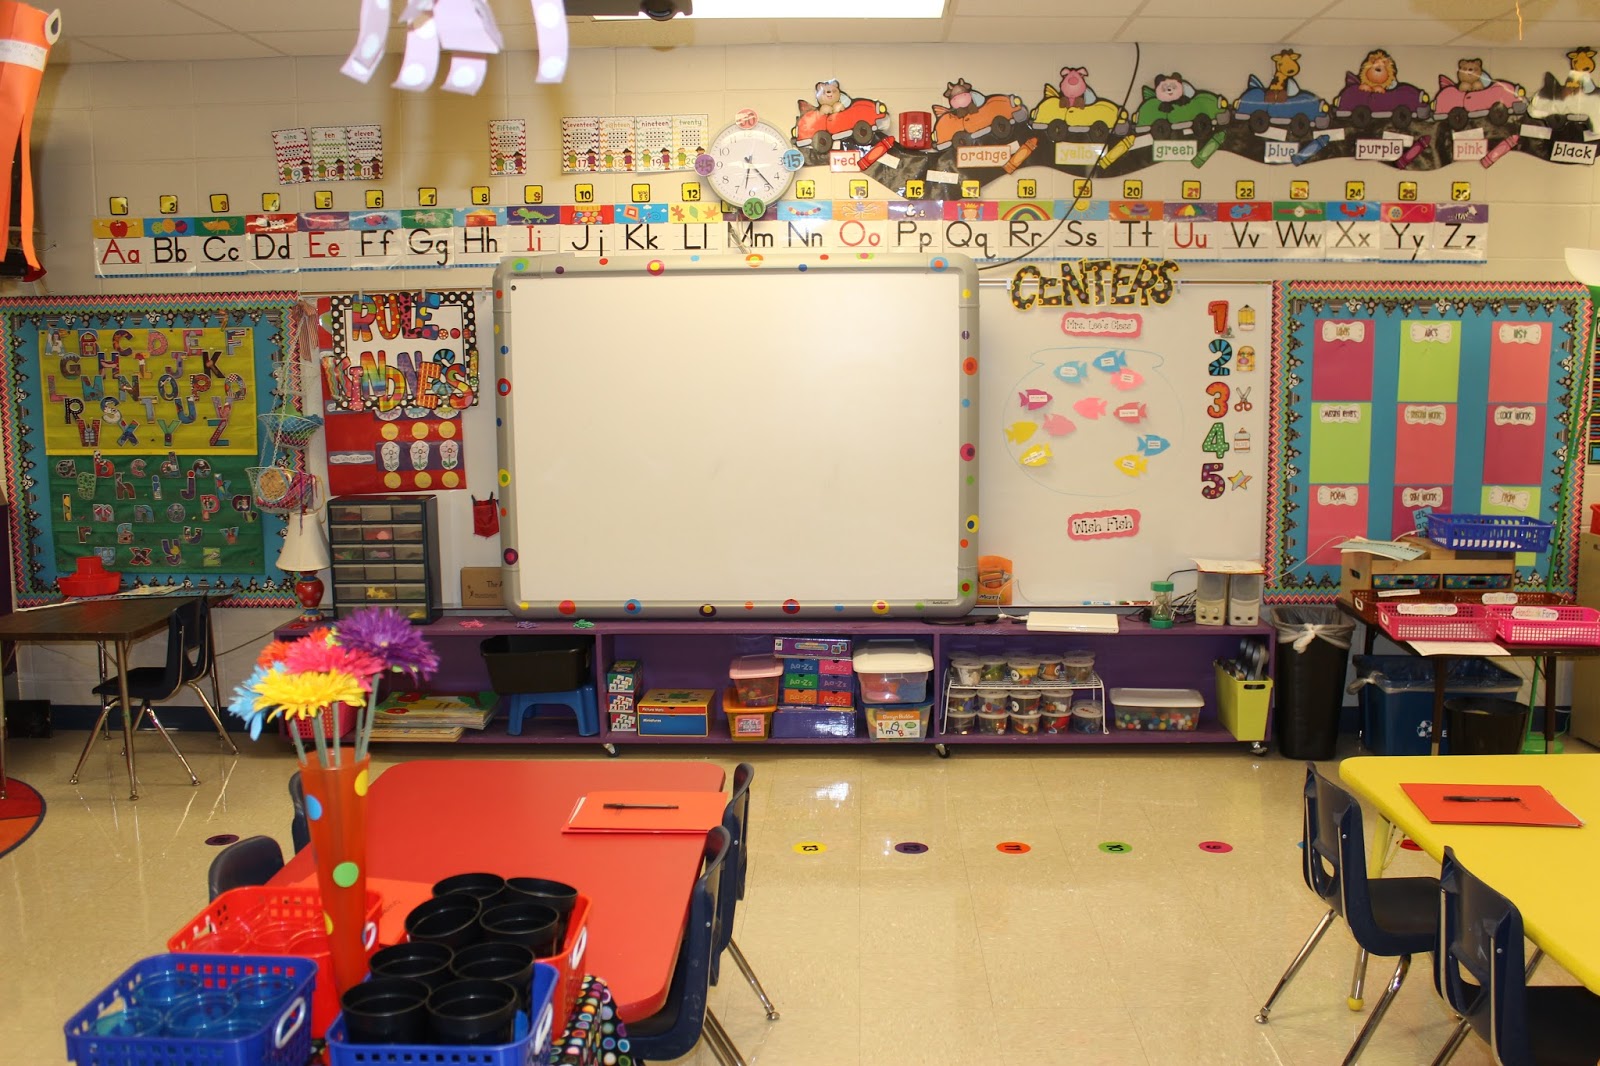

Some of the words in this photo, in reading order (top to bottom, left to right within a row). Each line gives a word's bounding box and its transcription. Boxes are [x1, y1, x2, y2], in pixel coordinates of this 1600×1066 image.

[497, 124, 520, 132] fifteen
[679, 119, 702, 128] twenty
[720, 148, 730, 156] 10
[960, 150, 1008, 164] orange
[1061, 148, 1099, 161] yello
[1156, 144, 1194, 158] green
[1268, 144, 1295, 156] blue
[1358, 142, 1400, 158] purple
[1457, 142, 1483, 158] pink
[1554, 144, 1592, 159] black
[504, 162, 514, 170] 15
[578, 160, 586, 168] 17
[614, 159, 623, 168] 18
[652, 159, 662, 167] 19
[716, 162, 724, 170] 9
[834, 154, 857, 166] red
[294, 169, 300, 180] 9
[363, 168, 370, 176] 11
[722, 176, 730, 184] 8
[735, 186, 740, 194] 7
[748, 189, 756, 197] 6
[120, 204, 126, 213] 1
[170, 202, 175, 212] 2
[221, 201, 228, 210] 3
[271, 200, 278, 209] 4
[324, 198, 332, 207] 5
[374, 197, 382, 206] 6
[428, 194, 435, 204] 7
[481, 193, 488, 202] 8
[579, 190, 591, 200] 10
[686, 189, 698, 199] 12
[800, 187, 812, 197] 14
[910, 186, 922, 196] 16
[1022, 186, 1034, 196] 18
[1126, 187, 1140, 197] 20
[1240, 188, 1252, 198] 22
[1349, 188, 1362, 198] 24
[1402, 188, 1416, 198] 25
[1455, 188, 1468, 199] 26
[745, 201, 763, 216] :30
[102, 238, 140, 264] Aa
[154, 237, 188, 263] Bb
[202, 236, 240, 262] Cc
[254, 234, 290, 260] Dd
[308, 232, 340, 258] Ee
[360, 230, 394, 256] Ff
[408, 228, 448, 266] Gg
[464, 227, 498, 253] Hh
[526, 225, 541, 252] Ii
[572, 224, 604, 257] Jj
[626, 224, 658, 250] Kk
[684, 223, 707, 250] Ll
[727, 221, 773, 248] Mm
[788, 221, 822, 248] Nn
[839, 220, 881, 248] Oo
[898, 220, 932, 252] Pp
[946, 220, 996, 260] Qq
[1009, 221, 1042, 246] Rr
[1065, 220, 1098, 248] Ss
[1120, 220, 1152, 247] Tt
[1174, 222, 1207, 248] Uu
[1230, 222, 1260, 248] Vv
[1276, 221, 1323, 248] Ww
[1336, 221, 1370, 248] Xx
[1390, 223, 1424, 261] Yy
[1444, 222, 1476, 248] Zz
[1010, 258, 1180, 312] CENTERS
[1067, 319, 1086, 330] Mrs.
[1208, 300, 1229, 334] 1
[44, 327, 66, 356] A
[78, 328, 98, 357] B
[112, 329, 134, 356] C
[148, 329, 168, 356] D
[182, 329, 204, 356] E
[225, 329, 246, 356] F
[1208, 338, 1232, 376] 2
[60, 352, 82, 380] G
[98, 352, 120, 380] H
[134, 352, 152, 380] I
[165, 351, 188, 379] J
[202, 350, 226, 378] K
[48, 374, 68, 402] L
[80, 374, 104, 402] M
[118, 374, 140, 402] N
[158, 374, 178, 402] O
[190, 373, 212, 402] P
[224, 373, 247, 401] Q
[1206, 382, 1231, 418] 3
[64, 398, 85, 424] R
[100, 396, 122, 424] S
[138, 396, 159, 424] T
[174, 396, 197, 424] U
[211, 396, 234, 420] V
[77, 419, 102, 448] W
[116, 419, 140, 447] X
[156, 419, 182, 447] Y
[206, 418, 230, 447] Z
[1202, 422, 1230, 459] 4
[114, 472, 136, 500] h
[180, 470, 196, 500] j
[1201, 462, 1226, 500] 5
[1074, 519, 1102, 534] Wish
[1106, 516, 1133, 531] Fish
[160, 538, 182, 566] y
